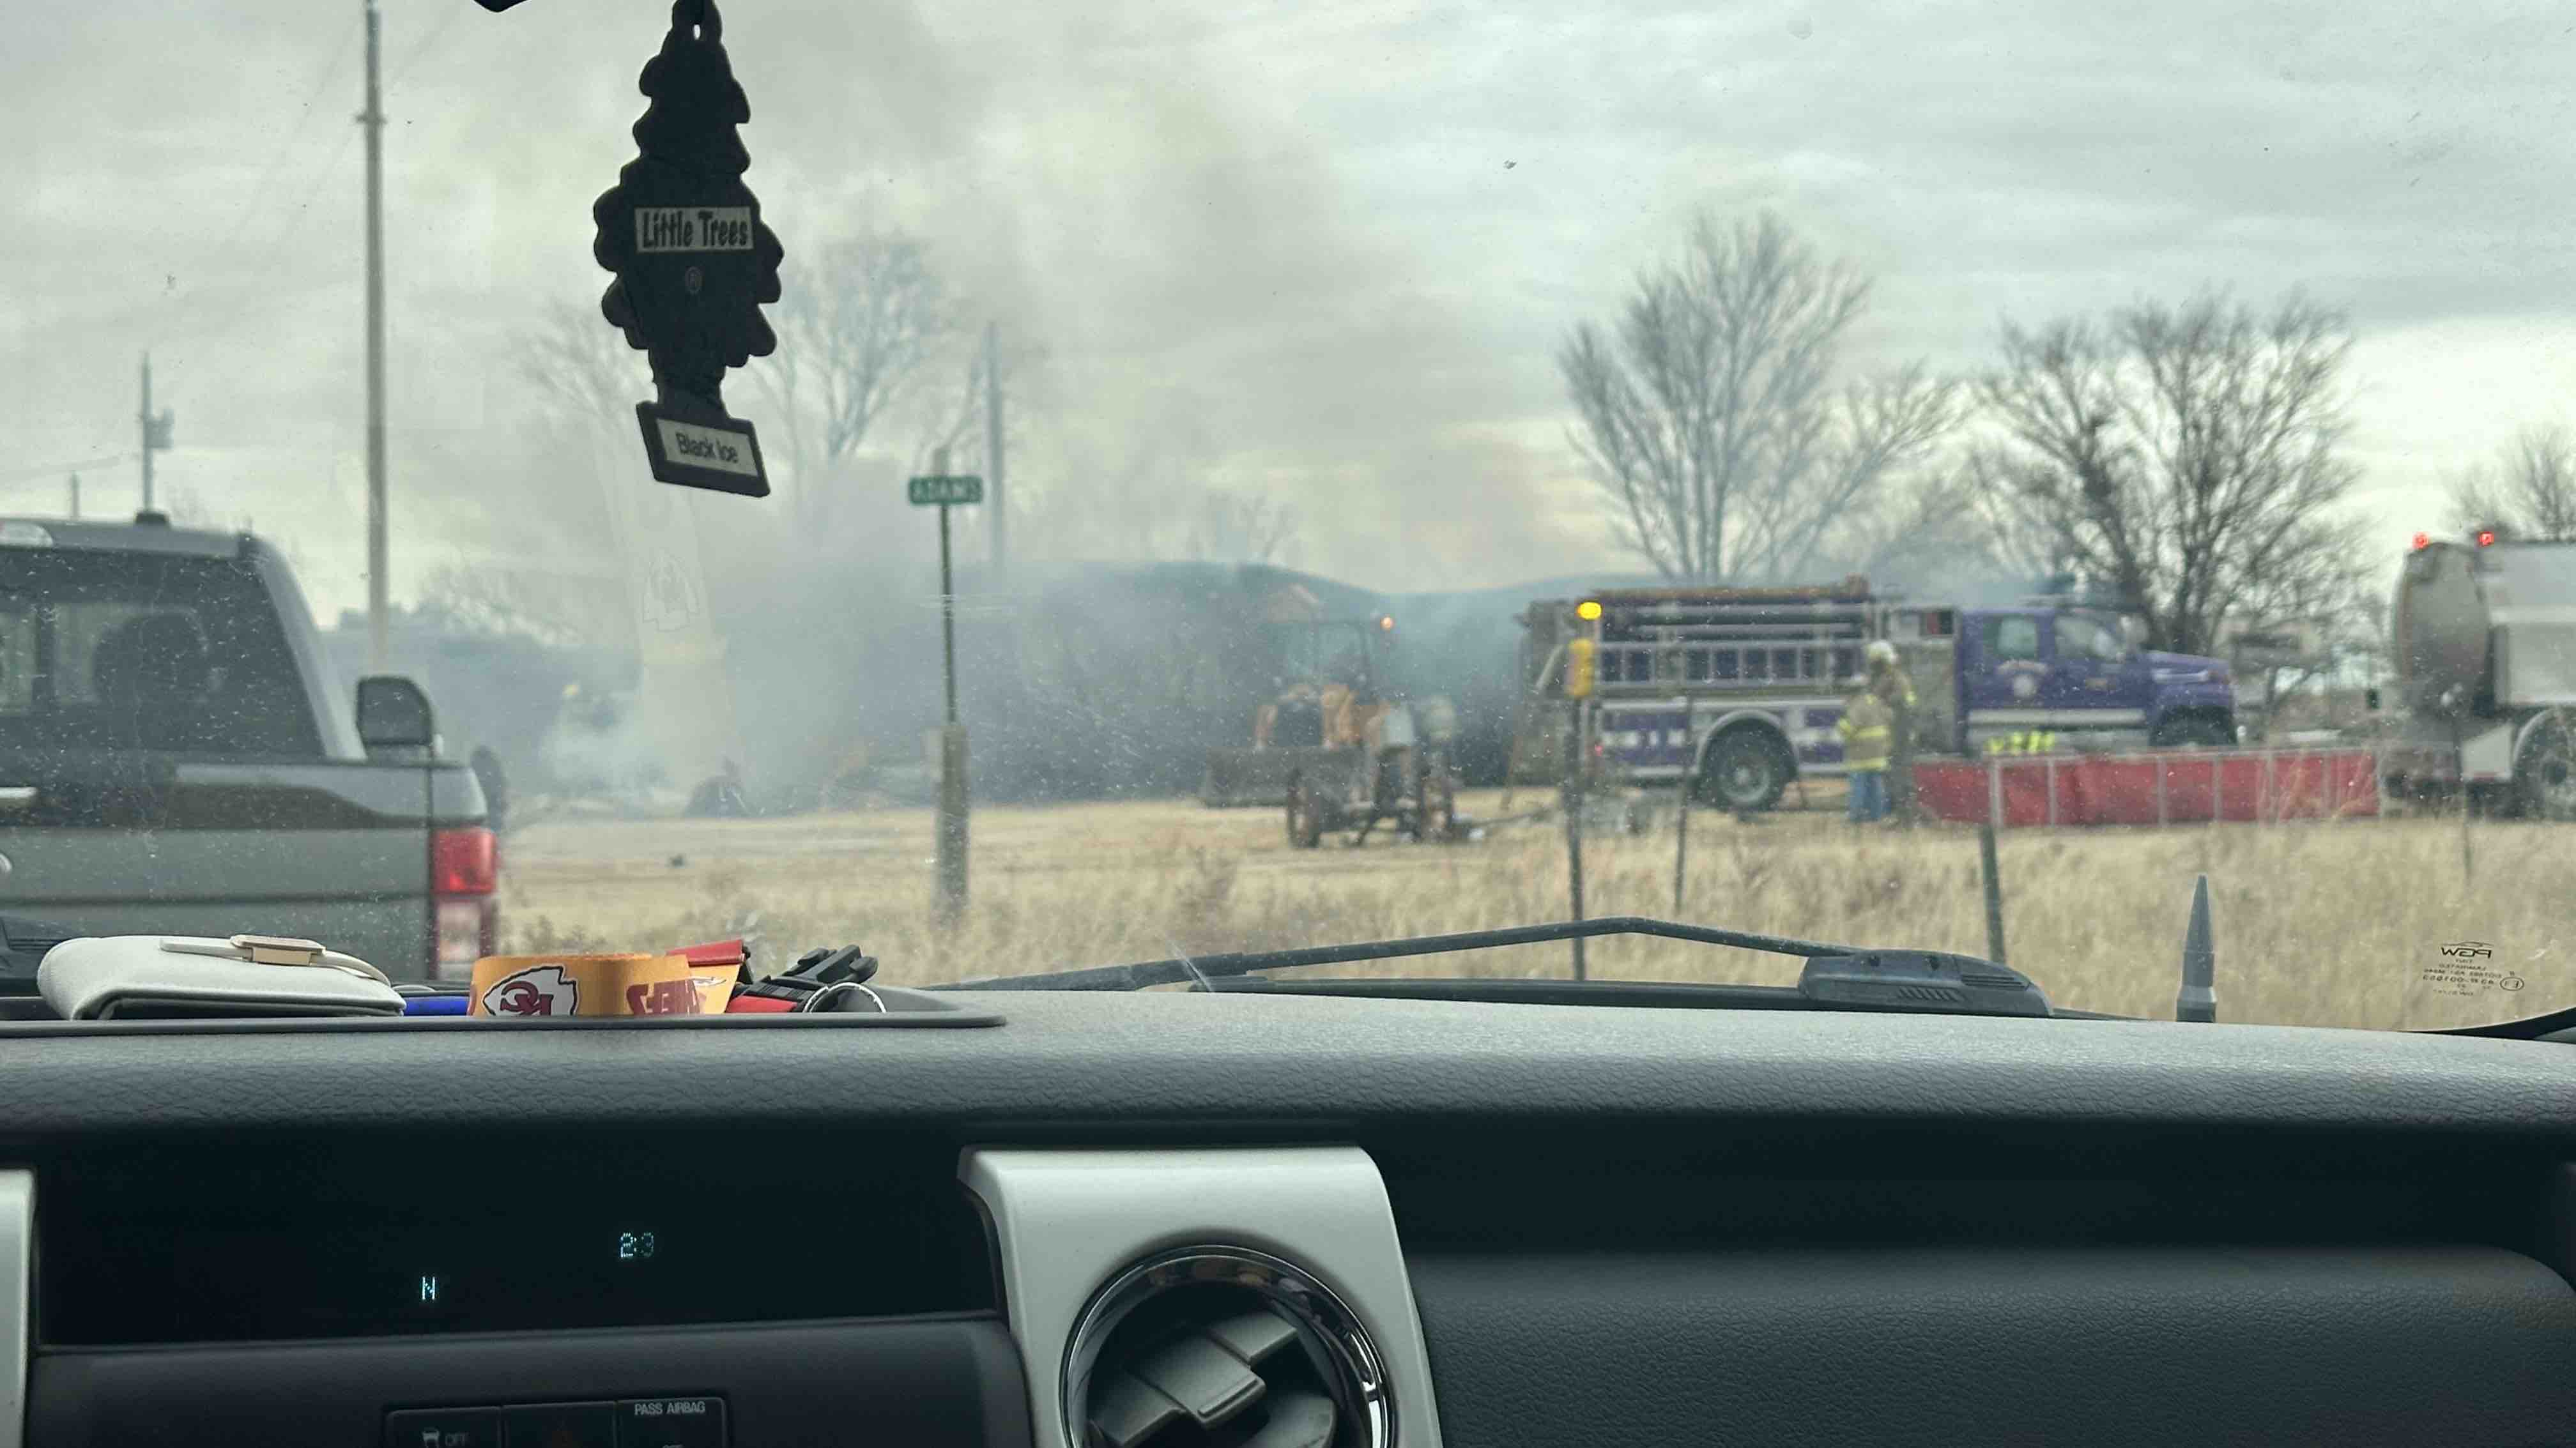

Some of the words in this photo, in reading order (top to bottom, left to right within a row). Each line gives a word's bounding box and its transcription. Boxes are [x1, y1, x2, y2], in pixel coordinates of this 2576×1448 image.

[643, 210, 693, 248] Little
[698, 210, 748, 247] Trees
[675, 432, 716, 457] Black
[715, 438, 739, 464] Ice
[422, 1276, 435, 1299] N
[634, 1403, 663, 1415] PASS
[666, 1401, 705, 1415] AIRBAG
